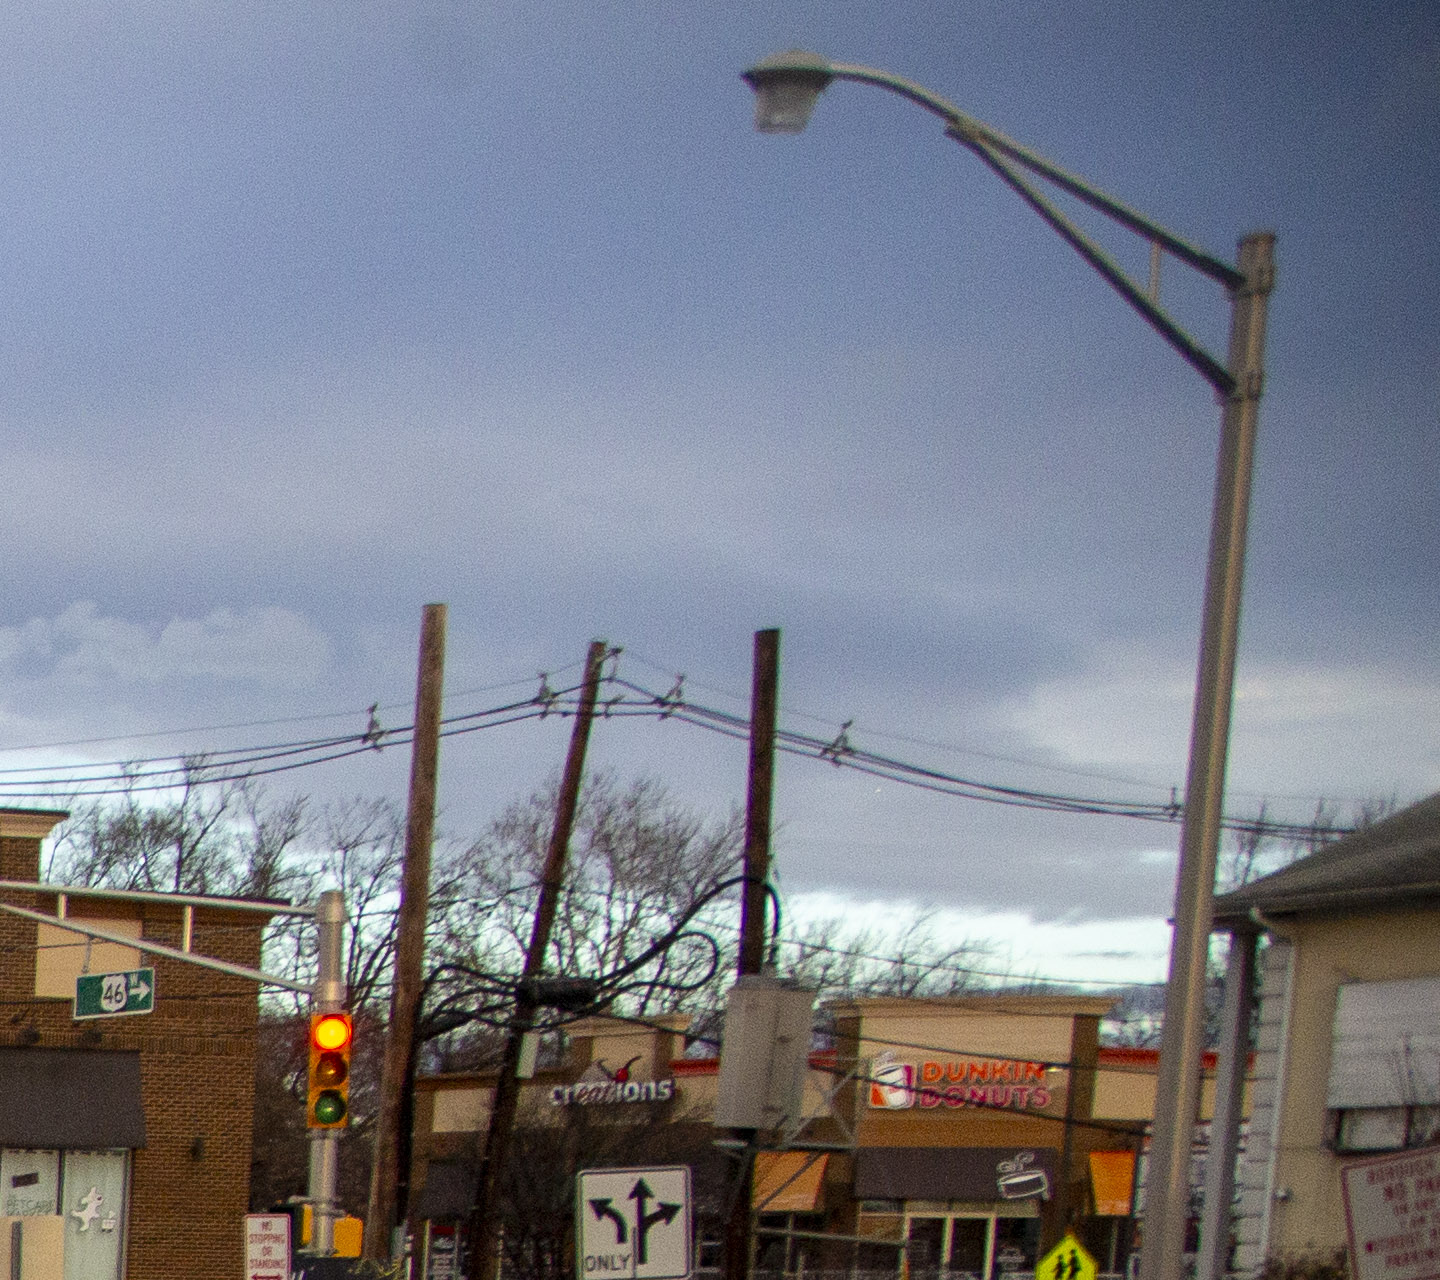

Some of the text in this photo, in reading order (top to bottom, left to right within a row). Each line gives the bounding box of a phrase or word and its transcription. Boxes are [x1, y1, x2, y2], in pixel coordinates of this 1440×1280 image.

[103, 983, 124, 1003] 46
[919, 1085, 1052, 1109] DONUTS
[261, 1221, 273, 1231] NO
[248, 1233, 286, 1245] STOPPING
[261, 1245, 273, 1256] OR
[248, 1258, 286, 1270] STANDING
[584, 1254, 630, 1272] ONLY
